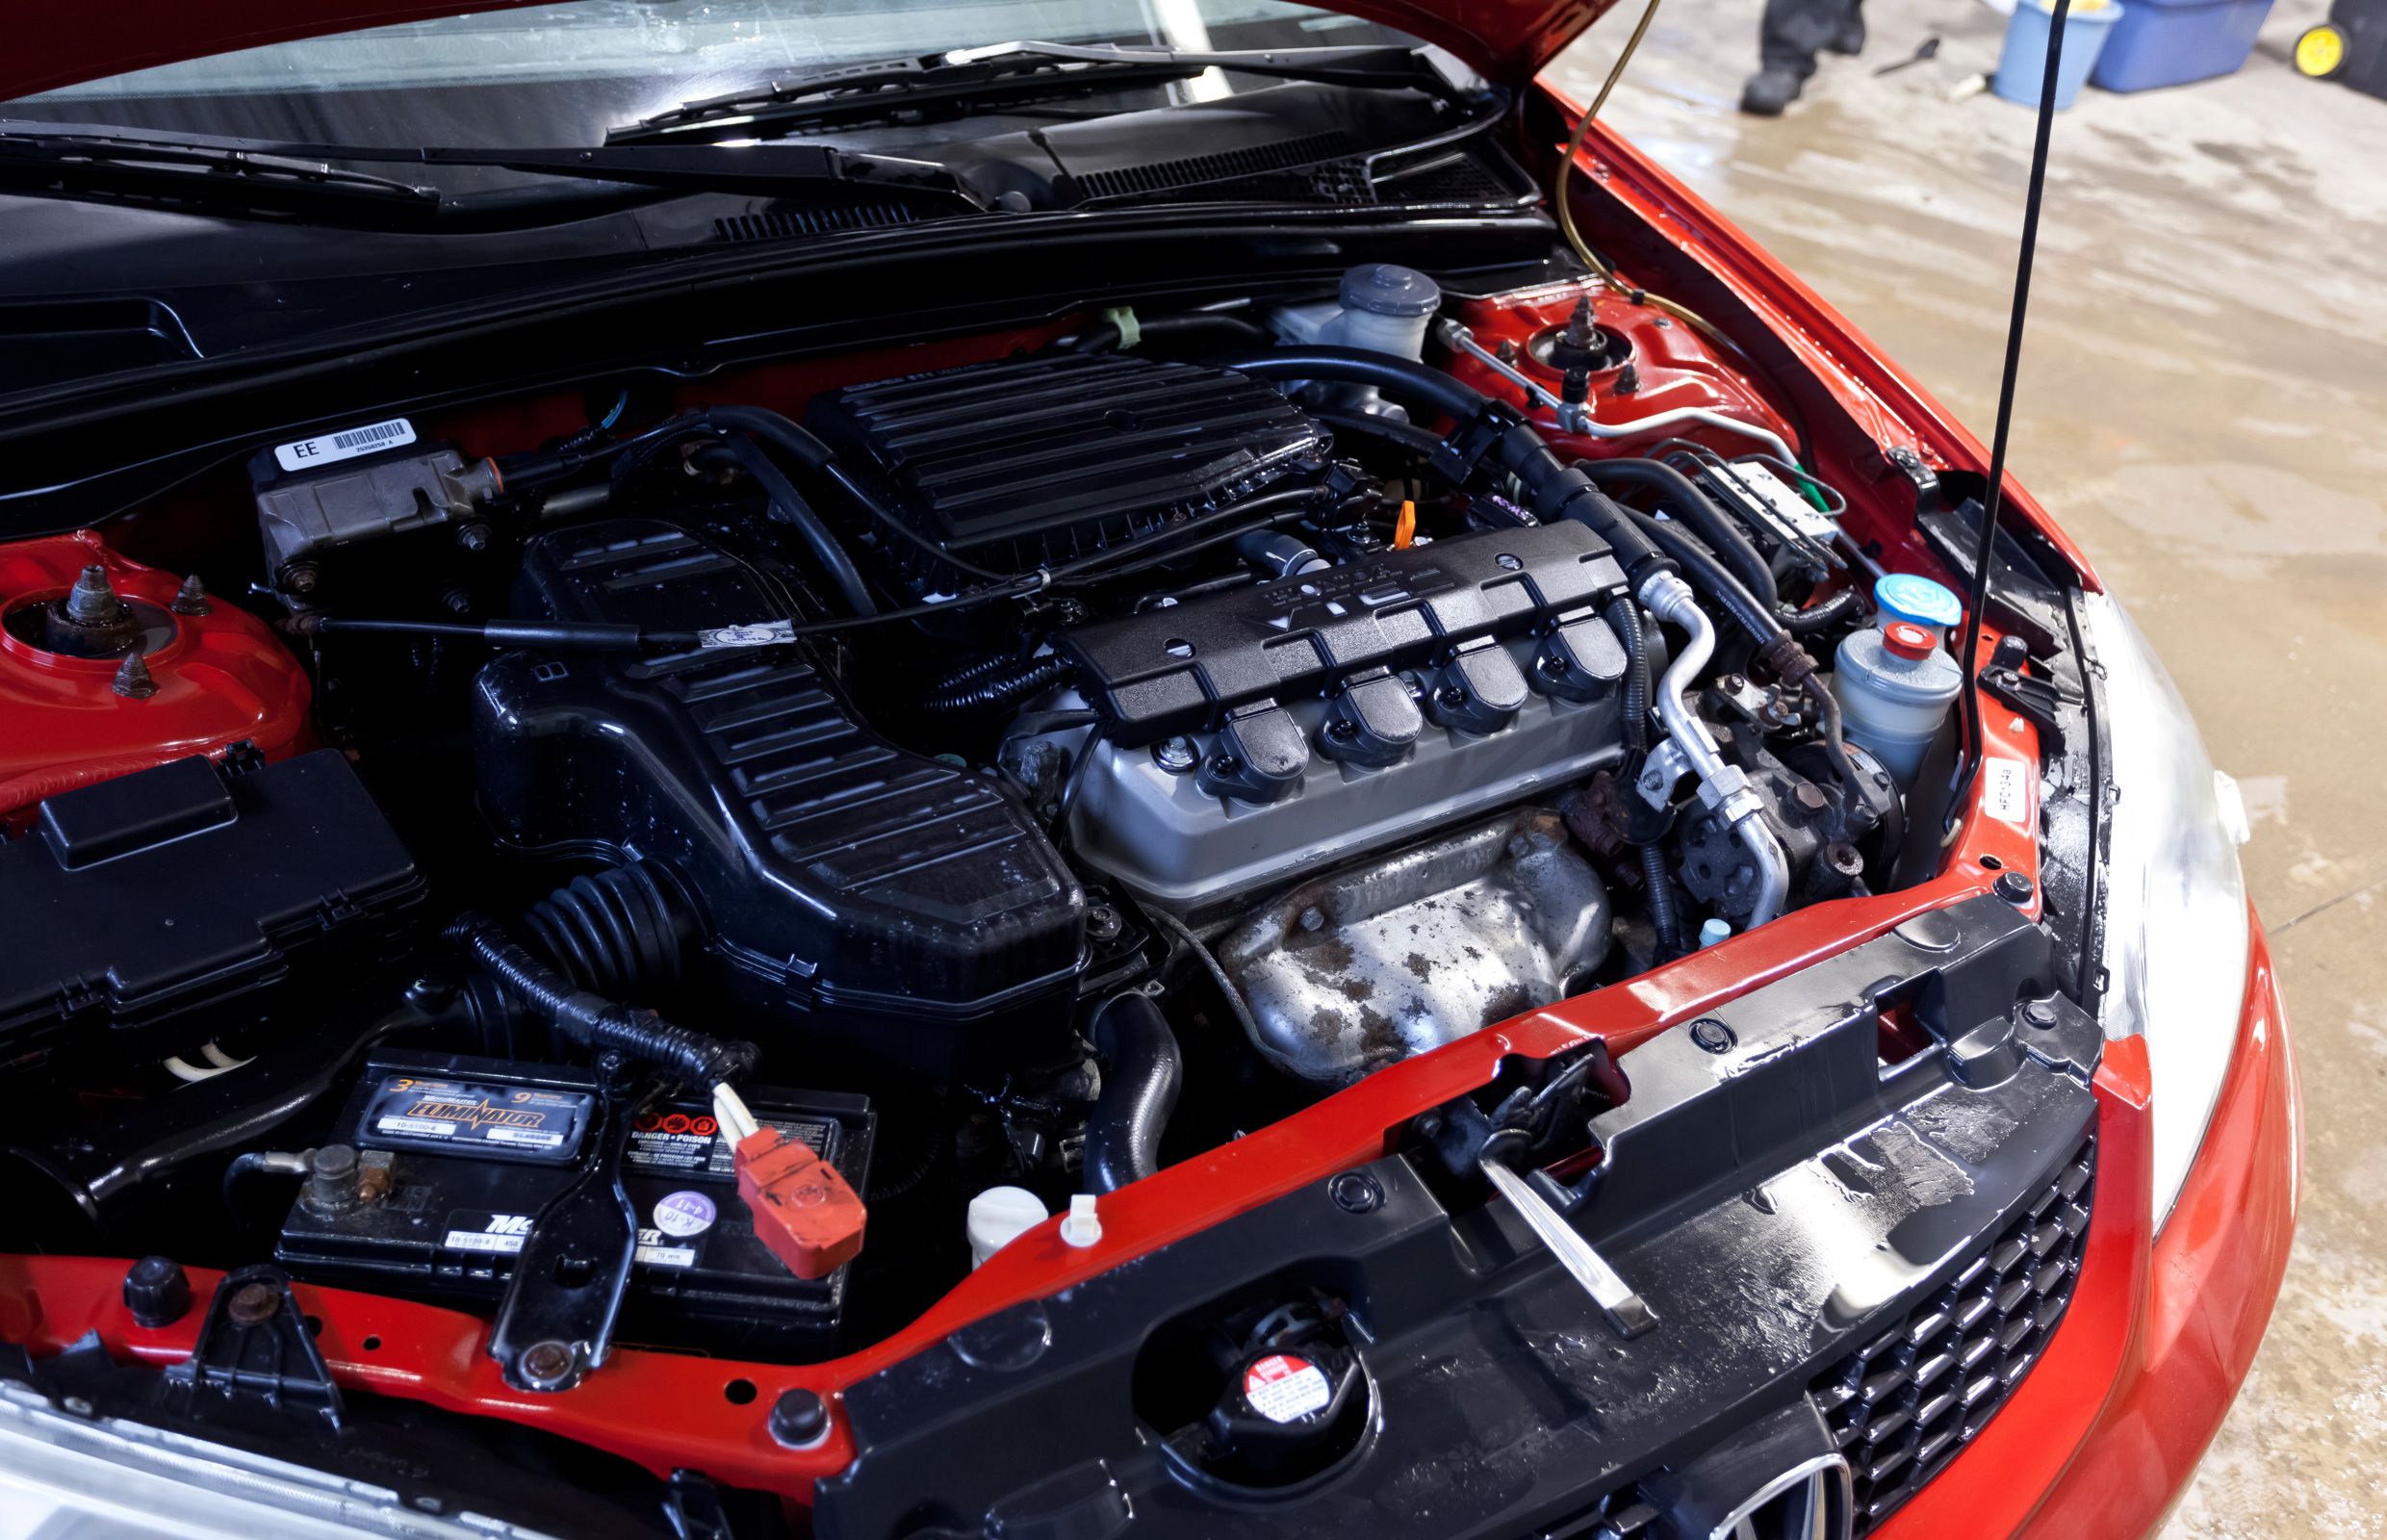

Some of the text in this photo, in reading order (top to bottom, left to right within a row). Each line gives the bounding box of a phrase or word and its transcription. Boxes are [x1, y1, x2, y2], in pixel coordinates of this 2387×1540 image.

[293, 441, 320, 458] EE
[388, 1078, 414, 1092] 3
[511, 1091, 531, 1103] 9
[406, 1098, 546, 1131] ELIMINATOR
[630, 1131, 712, 1144] DANGER POISON
[676, 1199, 704, 1215] 4-11
